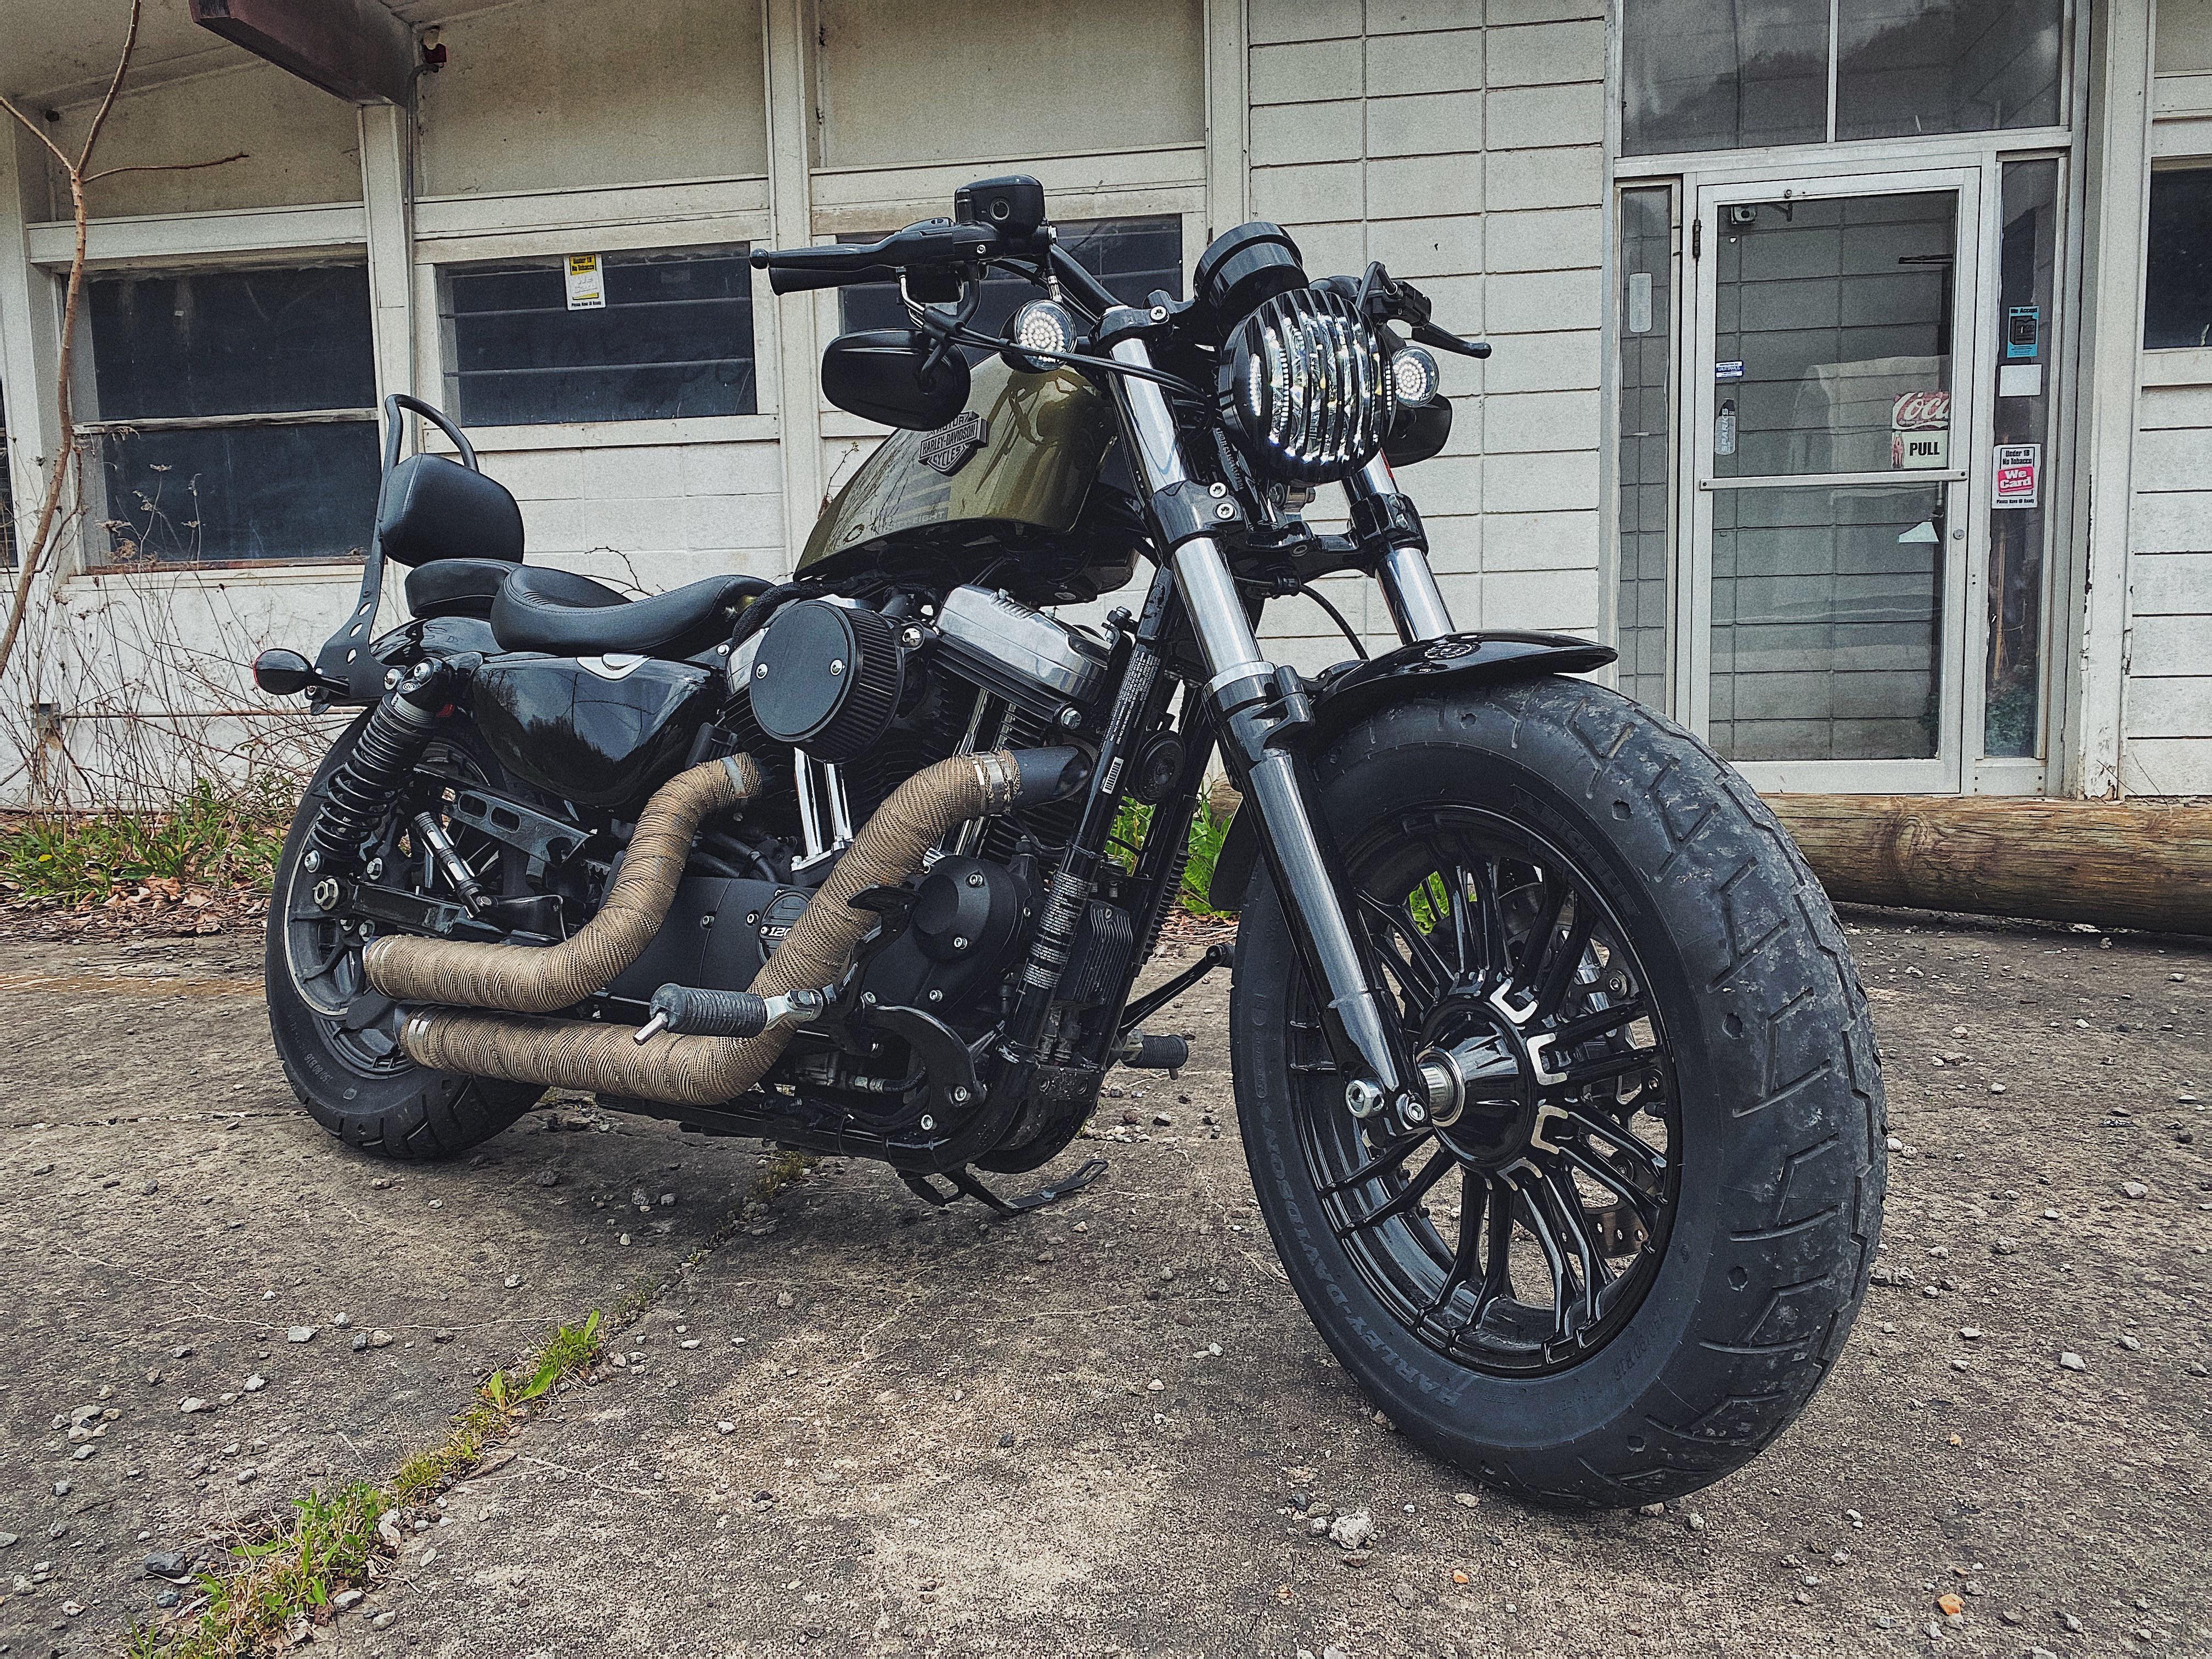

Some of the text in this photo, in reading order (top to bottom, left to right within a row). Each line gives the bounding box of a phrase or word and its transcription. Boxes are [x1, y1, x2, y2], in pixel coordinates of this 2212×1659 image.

[922, 422, 978, 455] HARLEY-DAVIDSON
[933, 446, 961, 467] CYCLES
[1910, 442, 1940, 456] PULL
[2000, 476, 2032, 488] Card
[2005, 470, 2027, 479] We
[1262, 1132, 1463, 1406] HARLEY-DAVIDSON
